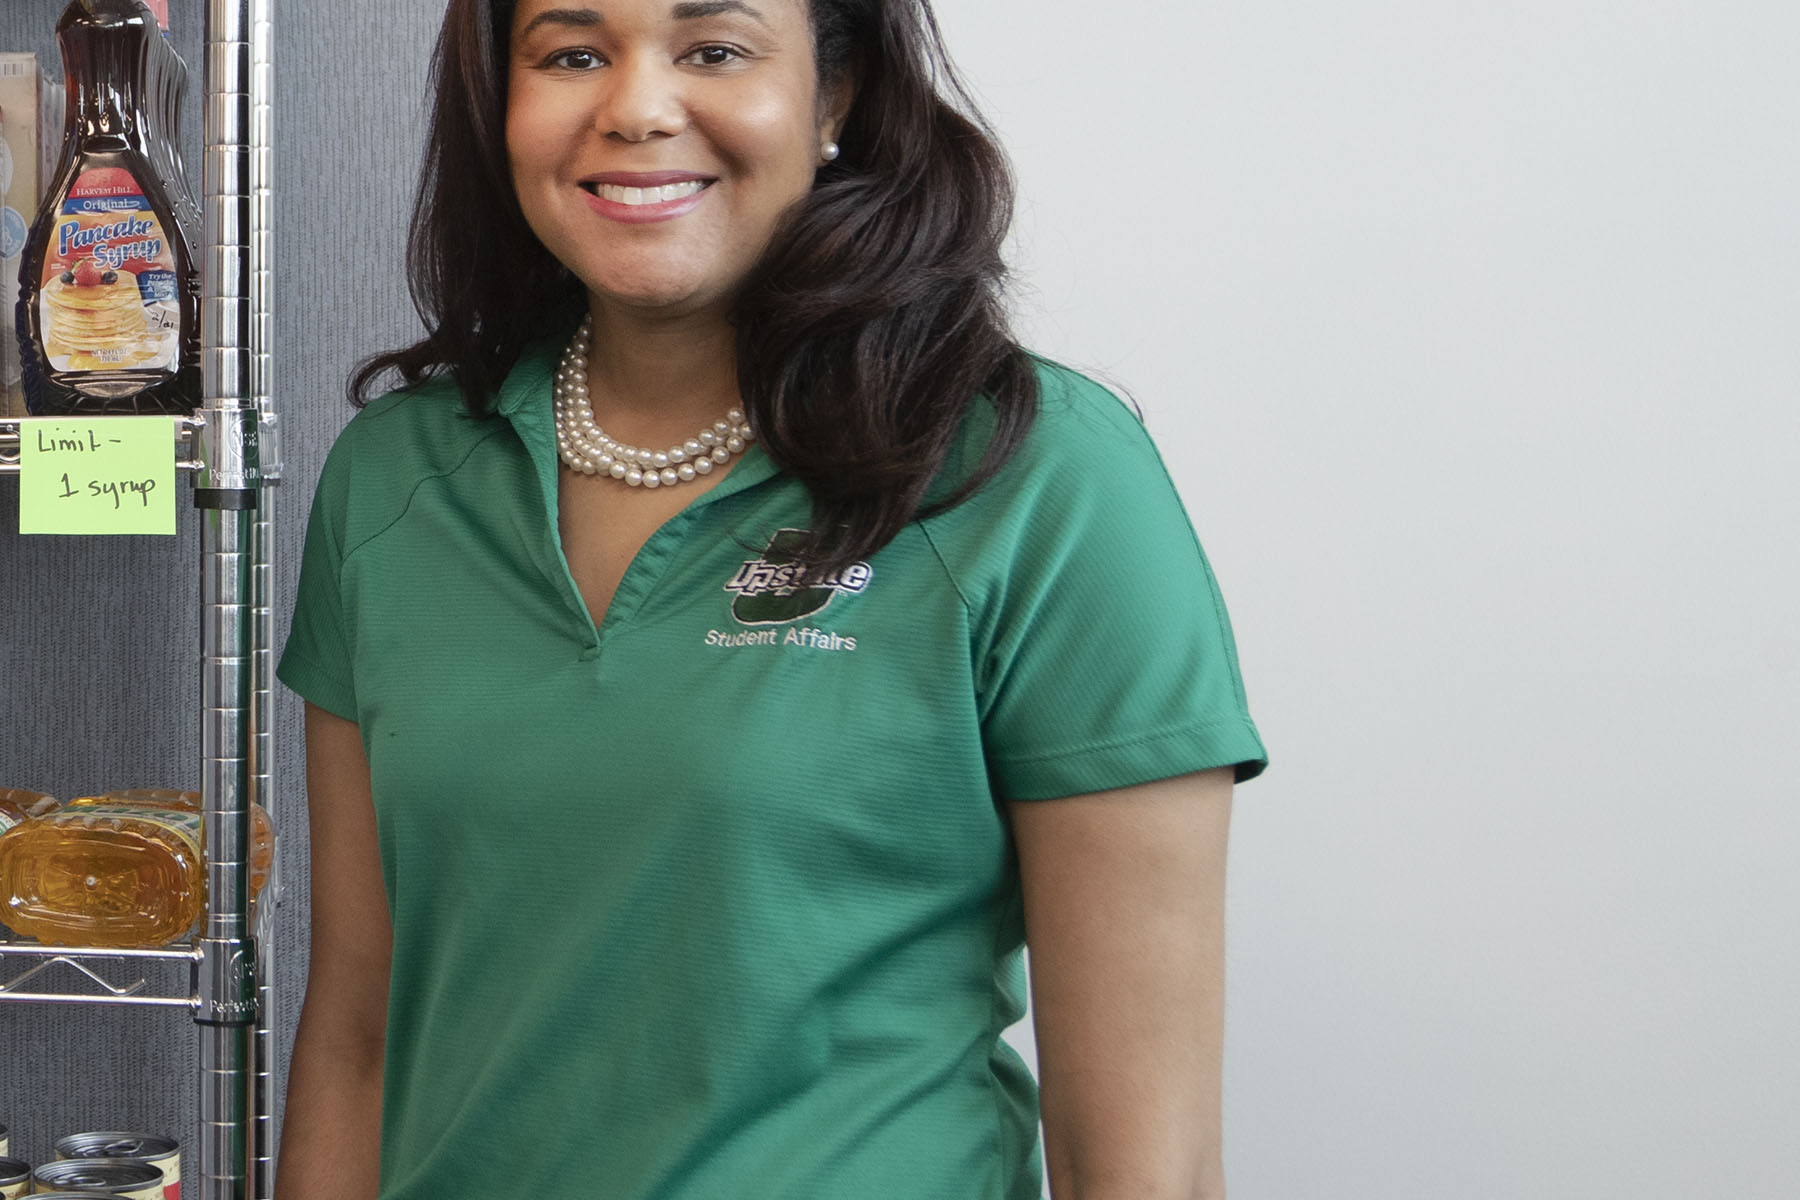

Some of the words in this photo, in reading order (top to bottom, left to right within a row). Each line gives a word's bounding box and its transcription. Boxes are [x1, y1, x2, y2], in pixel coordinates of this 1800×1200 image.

[83, 198, 129, 211] Original
[58, 215, 154, 257] Pancake
[92, 238, 162, 269] Syrup
[58, 472, 79, 498] 1
[88, 479, 156, 509] syrup
[704, 628, 778, 648] Student
[784, 626, 857, 651] Affairs
